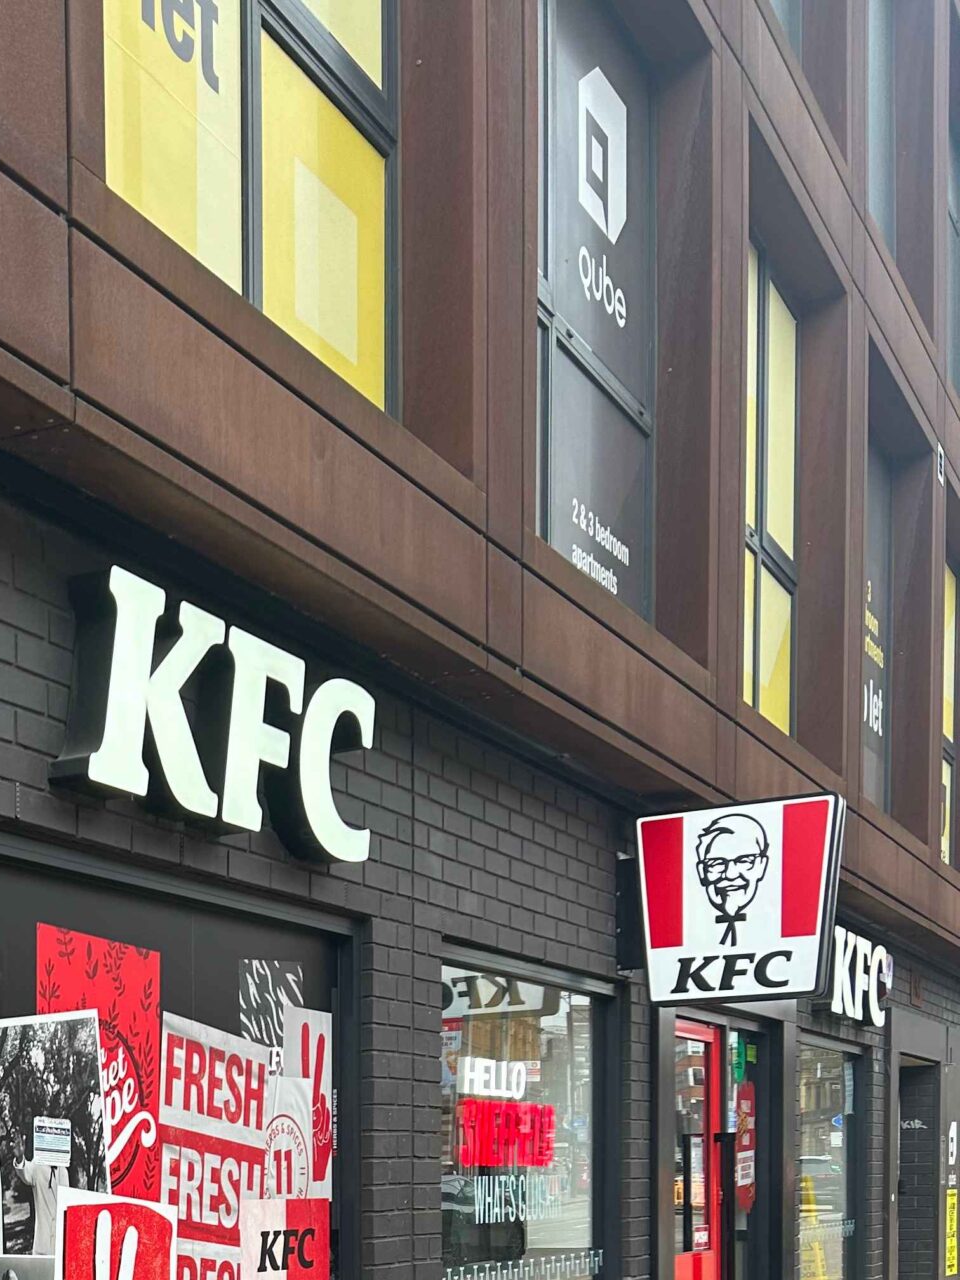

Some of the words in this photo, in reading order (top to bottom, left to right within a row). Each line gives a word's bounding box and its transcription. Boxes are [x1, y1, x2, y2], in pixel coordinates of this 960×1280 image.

[141, 0, 219, 94] et
[578, 245, 626, 328] Qube
[572, 497, 579, 525] 2
[579, 504, 586, 532] &
[588, 511, 594, 537] 3
[595, 516, 629, 567] bedroom
[572, 543, 618, 595] apartments
[88, 565, 375, 862] KFC
[670, 950, 793, 994] KFC
[831, 925, 888, 1028] KFC
[164, 1032, 265, 1131] FRESH
[463, 1056, 527, 1099] HELLO
[474, 1174, 516, 1224] WHAT'S
[257, 1228, 315, 1272] KFC
